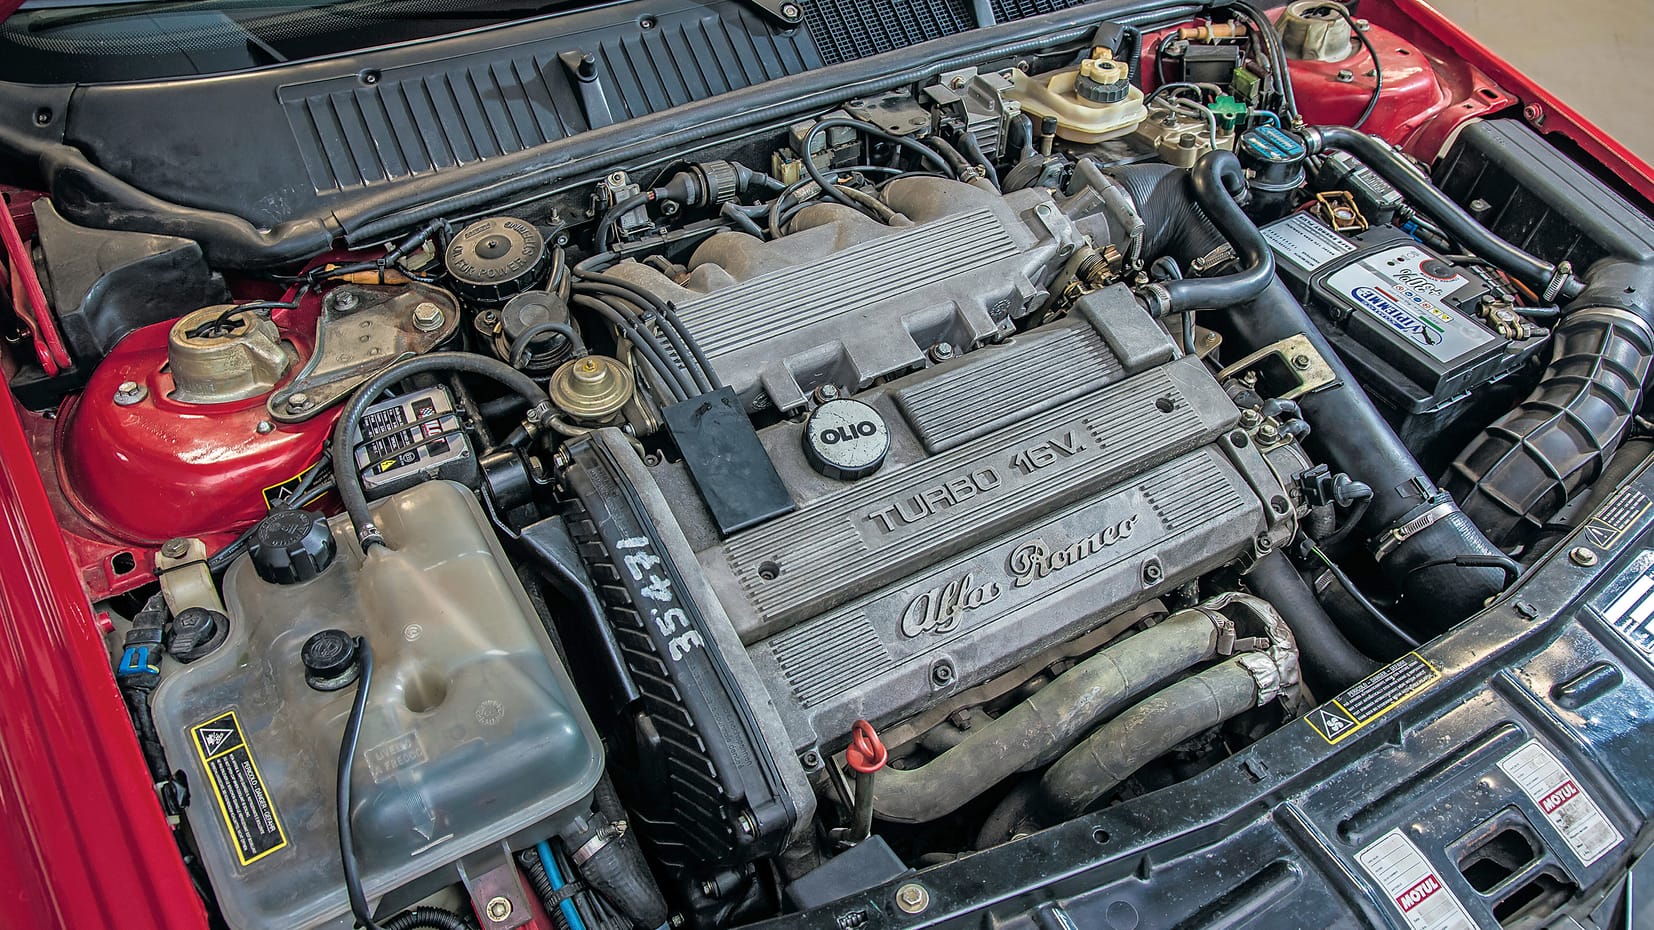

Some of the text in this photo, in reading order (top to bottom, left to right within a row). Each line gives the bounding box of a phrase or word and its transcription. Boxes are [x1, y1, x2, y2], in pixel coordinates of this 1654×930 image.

[478, 257, 528, 278] POWER
[1393, 268, 1443, 297] +30%
[1361, 290, 1422, 334] VIPIEMME
[820, 421, 876, 444] OLIO
[868, 465, 1002, 533] TURBO
[900, 513, 1140, 638] Alfa Romeo
[254, 788, 266, 810] DANGER
[1542, 783, 1578, 811] MOTUL
[1400, 878, 1439, 910] MOTUL
